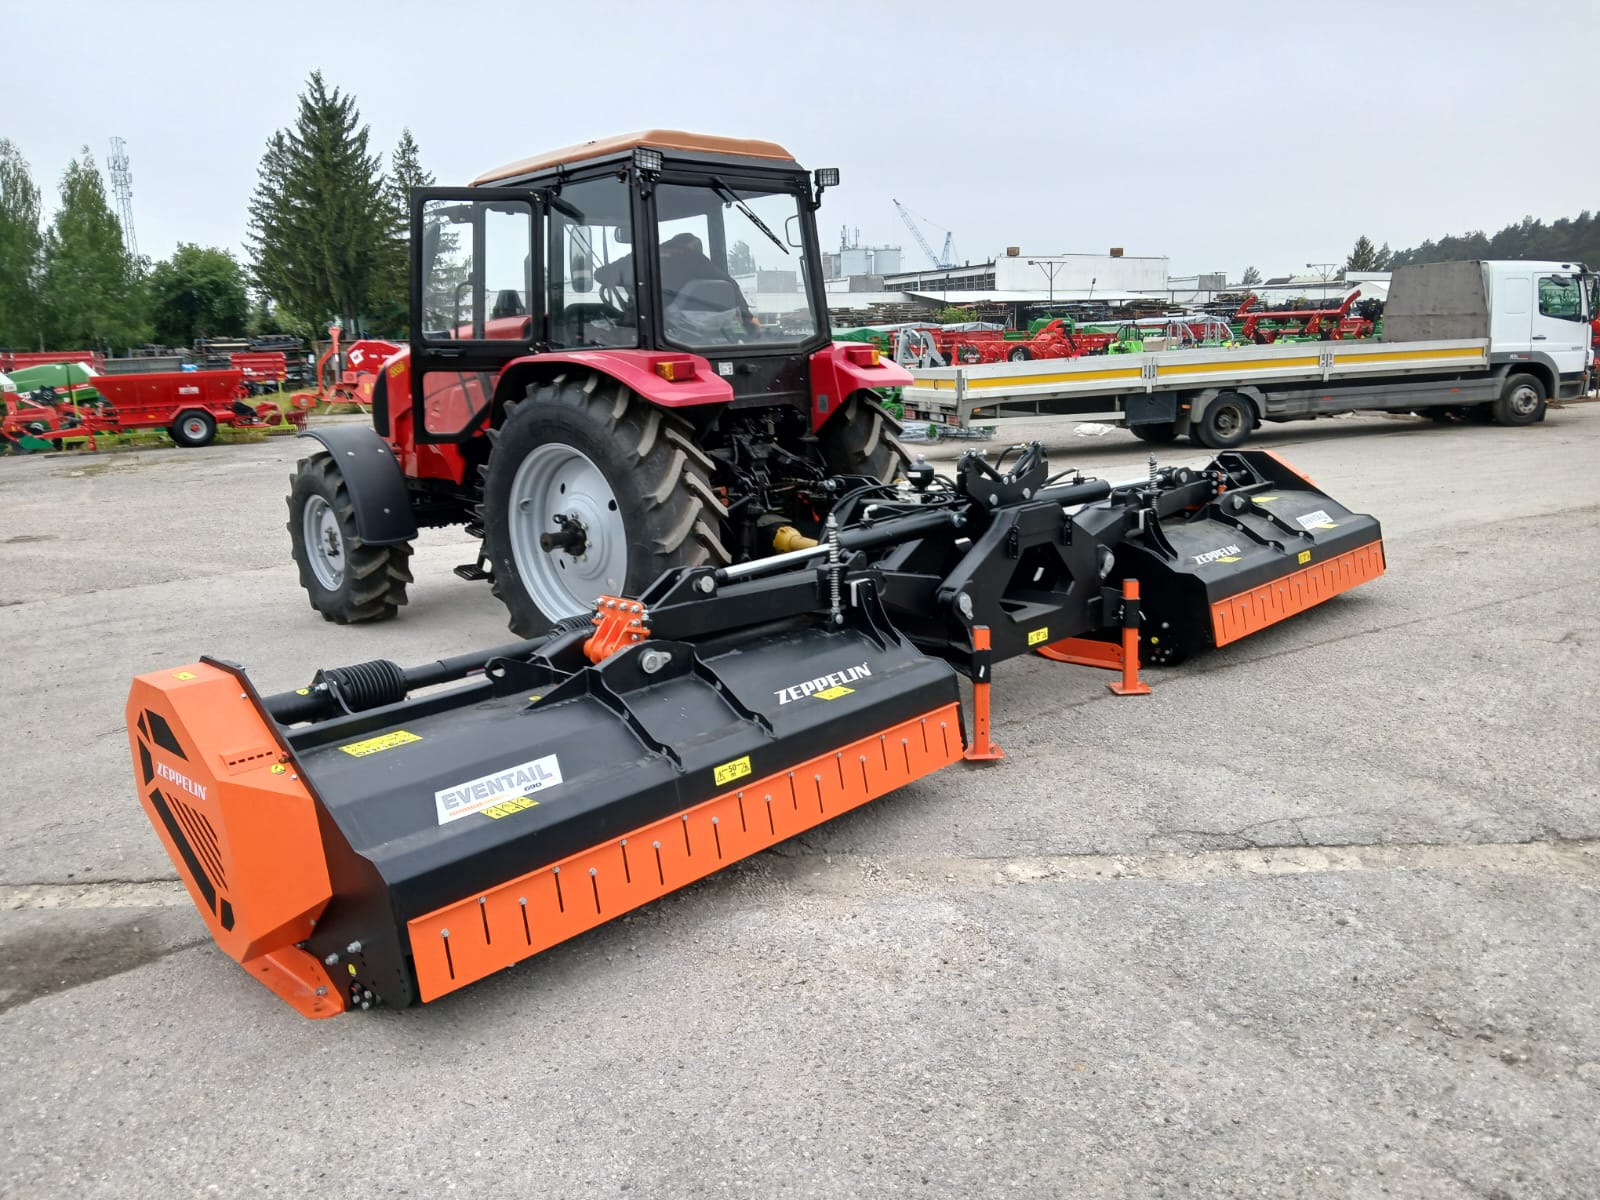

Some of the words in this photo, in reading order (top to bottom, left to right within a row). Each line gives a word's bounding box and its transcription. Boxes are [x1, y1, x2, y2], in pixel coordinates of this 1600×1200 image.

[1191, 544, 1241, 565] ZEPPELIN
[773, 661, 872, 705] ZEPPELIN
[157, 761, 207, 801] ZEPPELIN
[441, 763, 553, 811] EVENTAIL
